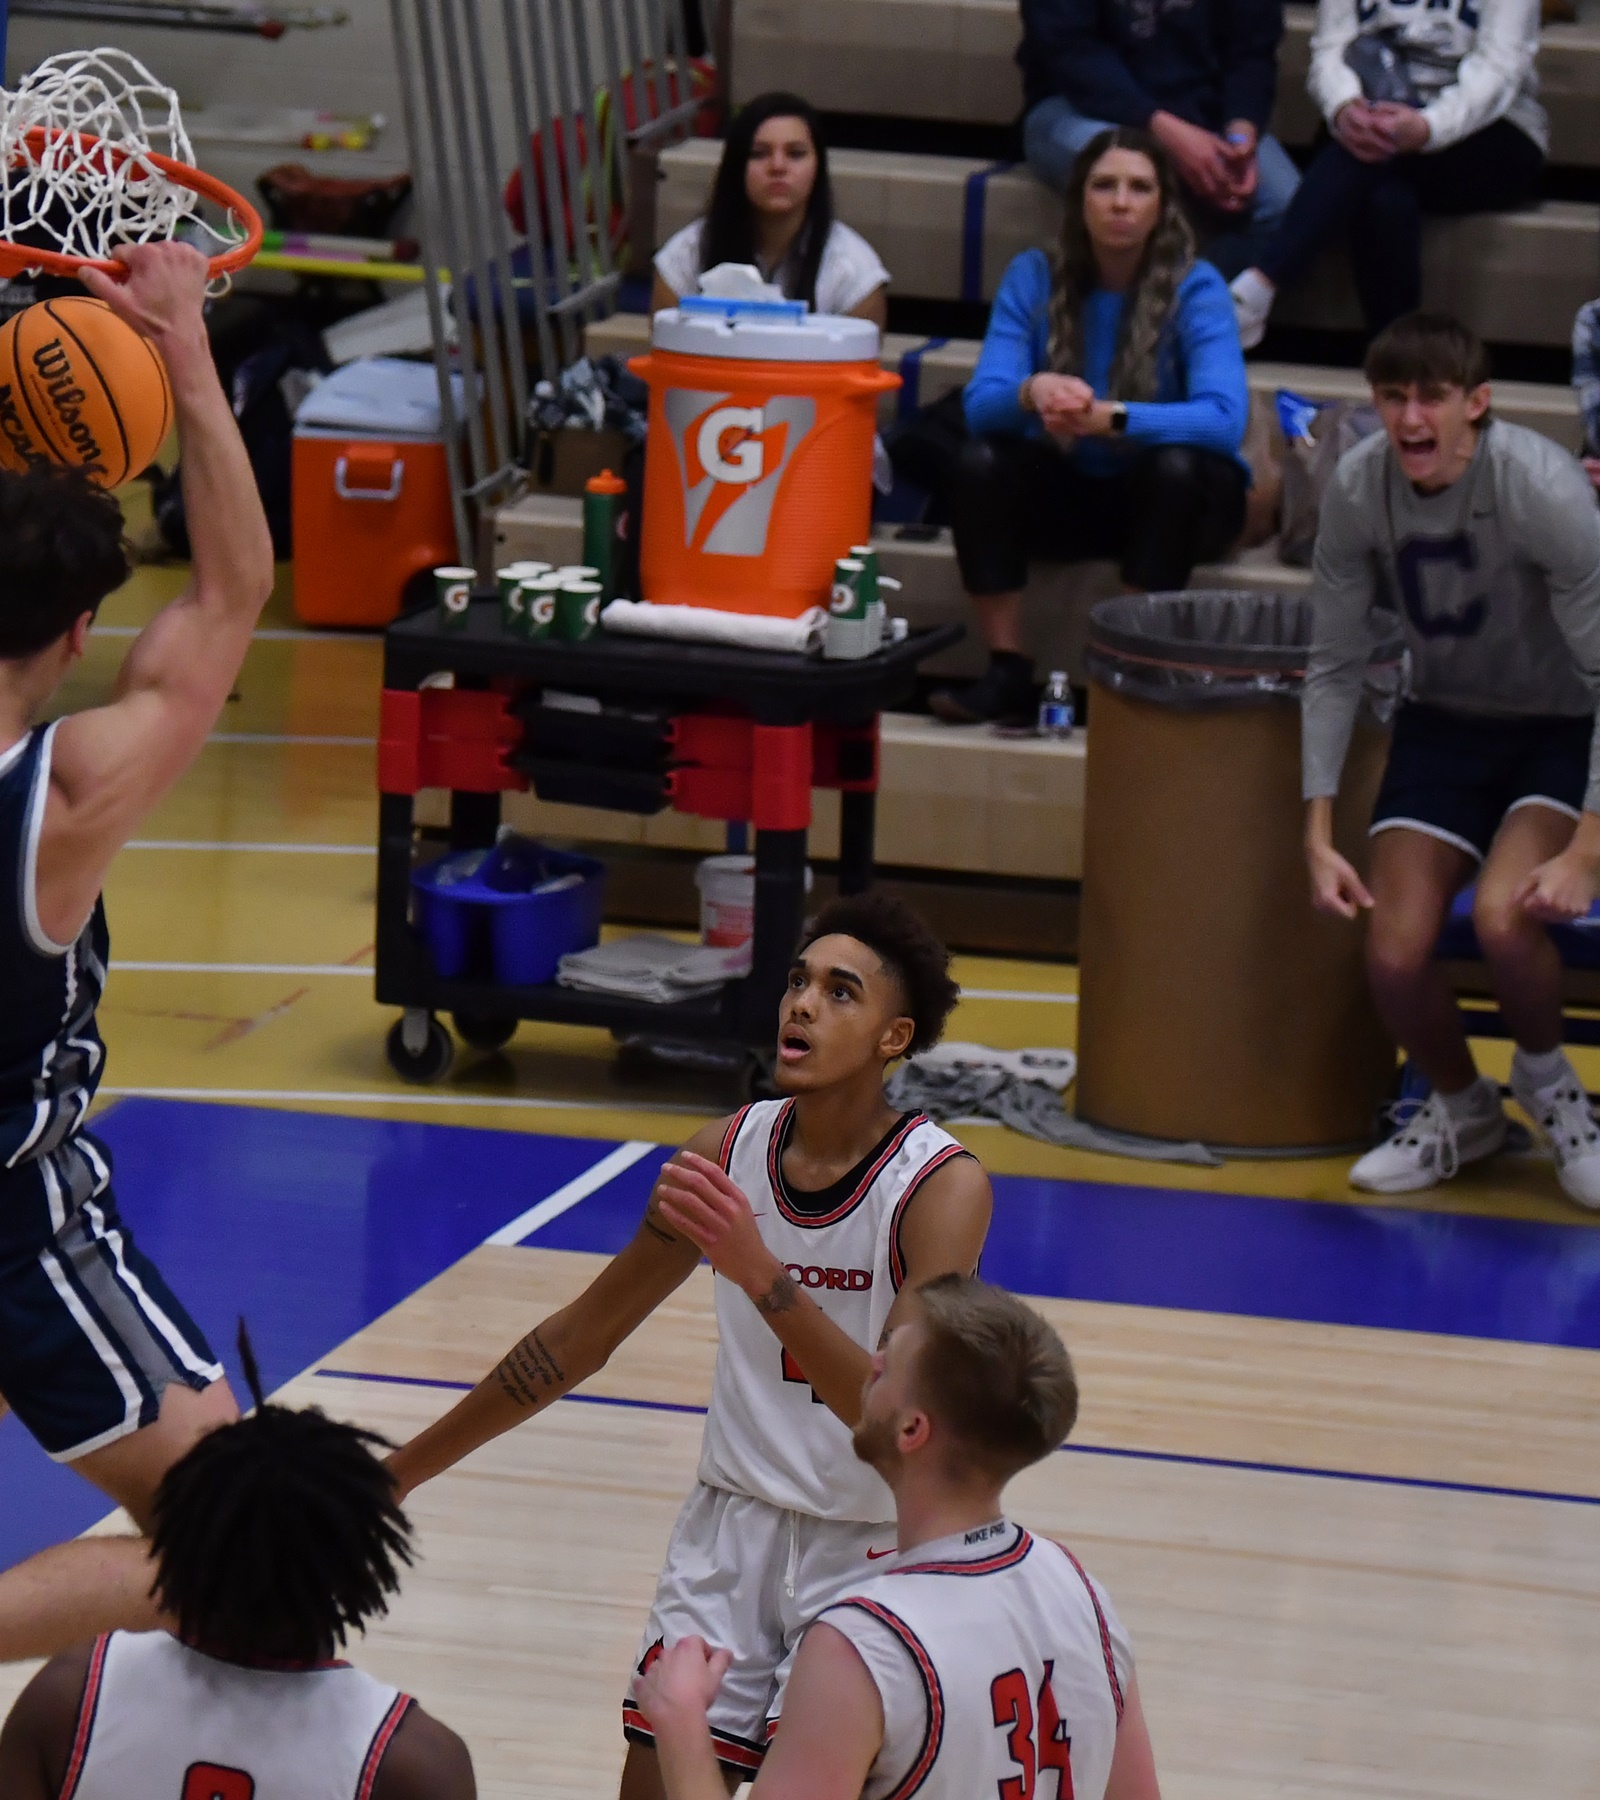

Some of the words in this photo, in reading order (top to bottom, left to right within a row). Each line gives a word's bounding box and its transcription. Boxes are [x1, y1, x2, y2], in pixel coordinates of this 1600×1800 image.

[33, 338, 101, 463] Wilson
[697, 407, 763, 484] G
[1398, 529, 1489, 640] C
[784, 1263, 873, 1291] CORD
[964, 1528, 988, 1545] NIKE
[990, 1660, 1075, 1800] 34
